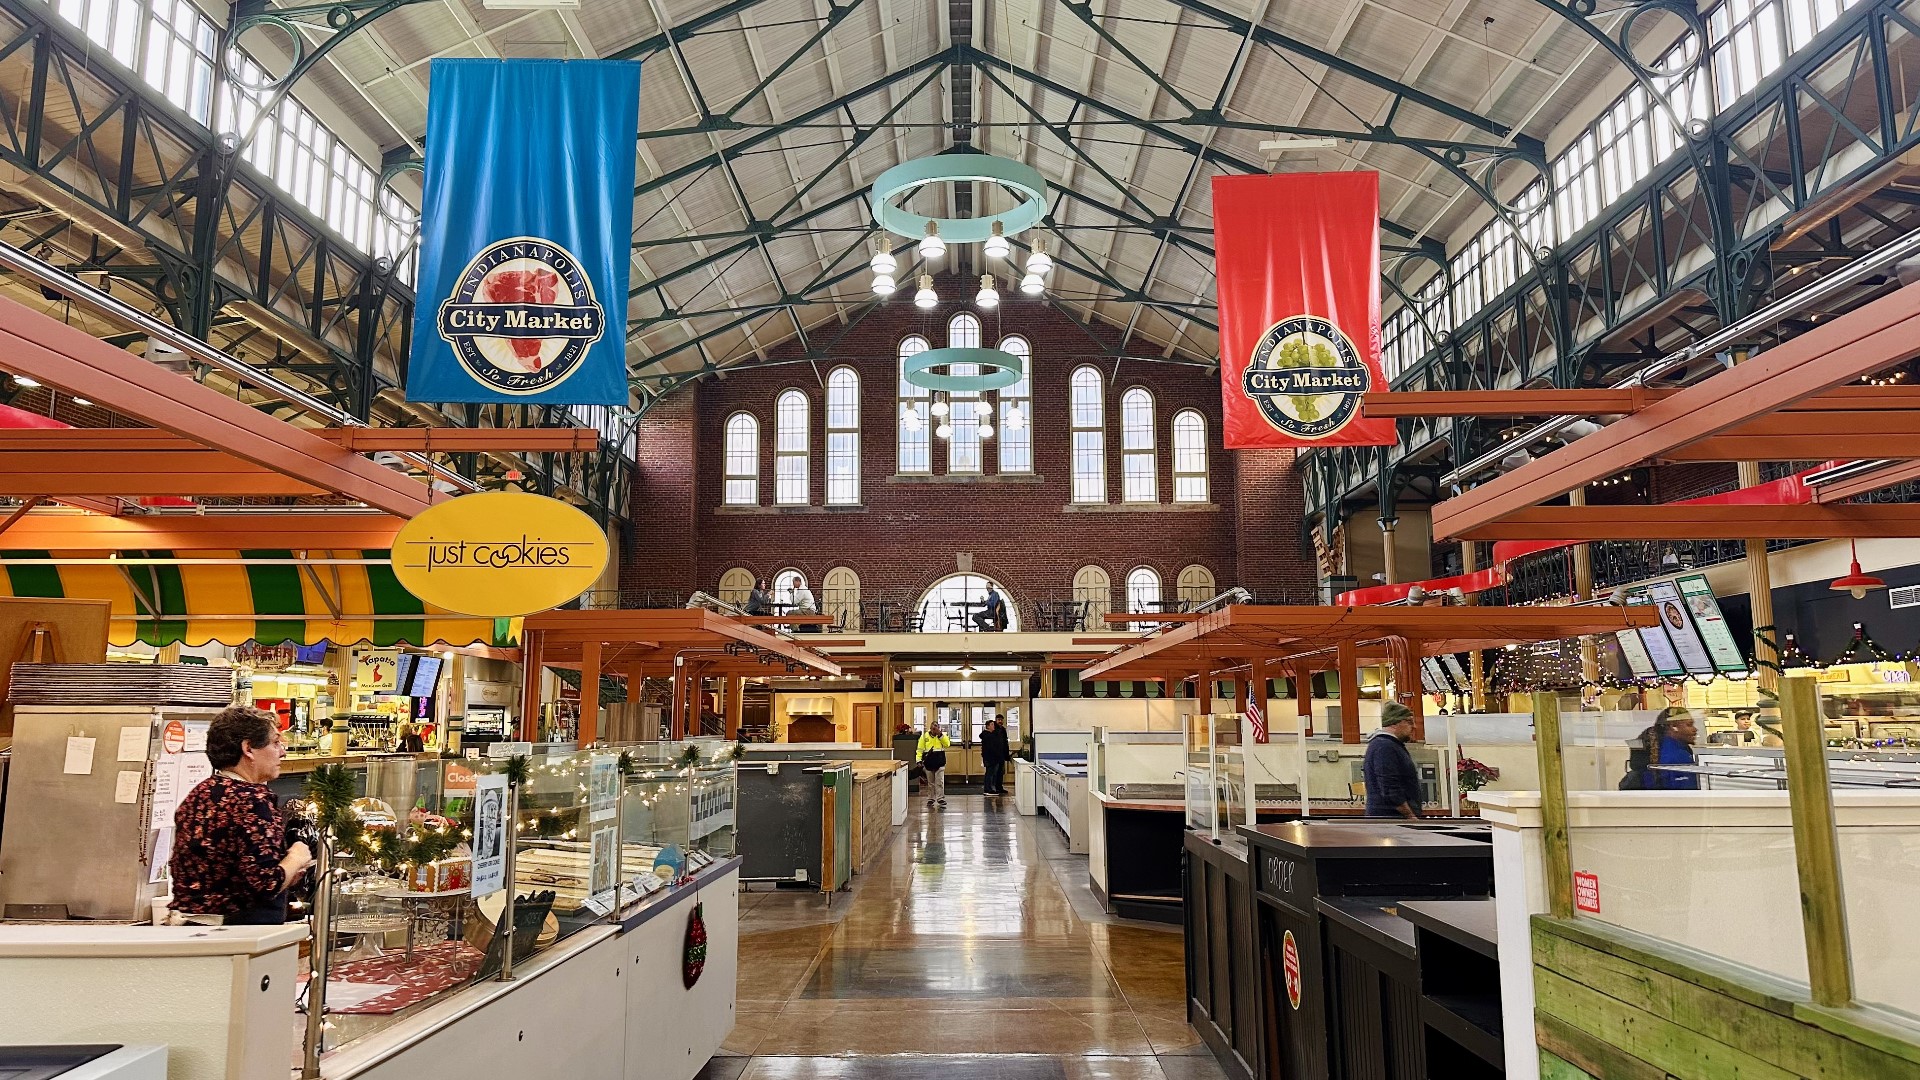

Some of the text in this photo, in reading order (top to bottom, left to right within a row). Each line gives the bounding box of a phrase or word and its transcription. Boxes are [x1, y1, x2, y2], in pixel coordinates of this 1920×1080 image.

[461, 245, 586, 299] INDIANAPOLIS
[450, 309, 592, 331] City Market
[462, 341, 477, 358] EST
[1258, 322, 1353, 364] INDIANAPOLIS
[564, 344, 578, 361] 1821
[482, 368, 554, 386] So Fresh
[1250, 372, 1361, 391] City Market
[1263, 399, 1275, 412] EST
[1280, 418, 1335, 432] So Fresh
[428, 534, 570, 573] just cookies
[447, 772, 477, 783] Close
[1268, 856, 1294, 894] ORDER
[1575, 876, 1597, 889] WOMEN
[1577, 886, 1598, 899] OWNED
